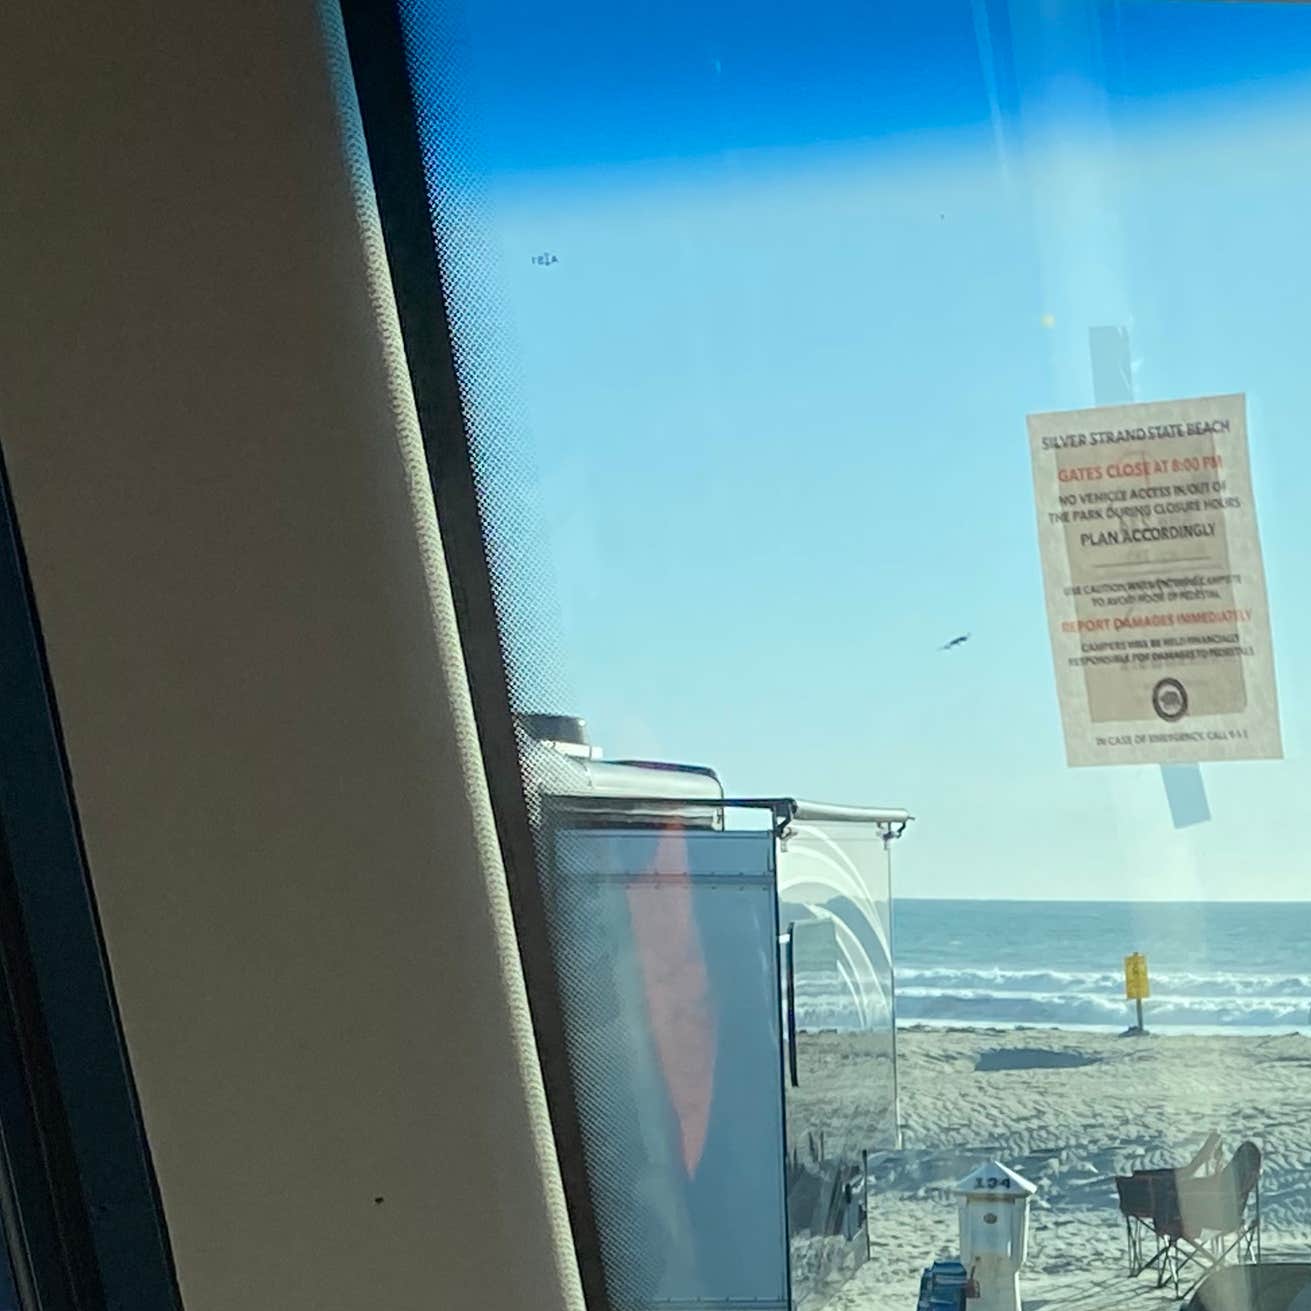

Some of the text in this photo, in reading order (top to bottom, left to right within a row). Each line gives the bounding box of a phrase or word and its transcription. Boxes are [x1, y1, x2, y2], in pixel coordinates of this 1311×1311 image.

[1041, 419, 1230, 450] SILVER STRAND STATE BEACH
[1057, 464, 1103, 482] GATES
[1107, 460, 1149, 479] CLOSE
[1153, 458, 1168, 474] AT
[1202, 454, 1222, 470] PM
[1059, 493, 1077, 507] NO
[1079, 488, 1127, 505] VEHICLE
[1130, 484, 1171, 500] ACCESS
[1049, 496, 1241, 524] THE PARK DURING CLOSURE HOURS
[1080, 529, 1118, 547] PLAN
[1062, 618, 1110, 632] REPORT
[1177, 608, 1252, 625] IMMEDIATELY
[1108, 735, 1132, 746] CASE
[1207, 730, 1228, 741] CALL
